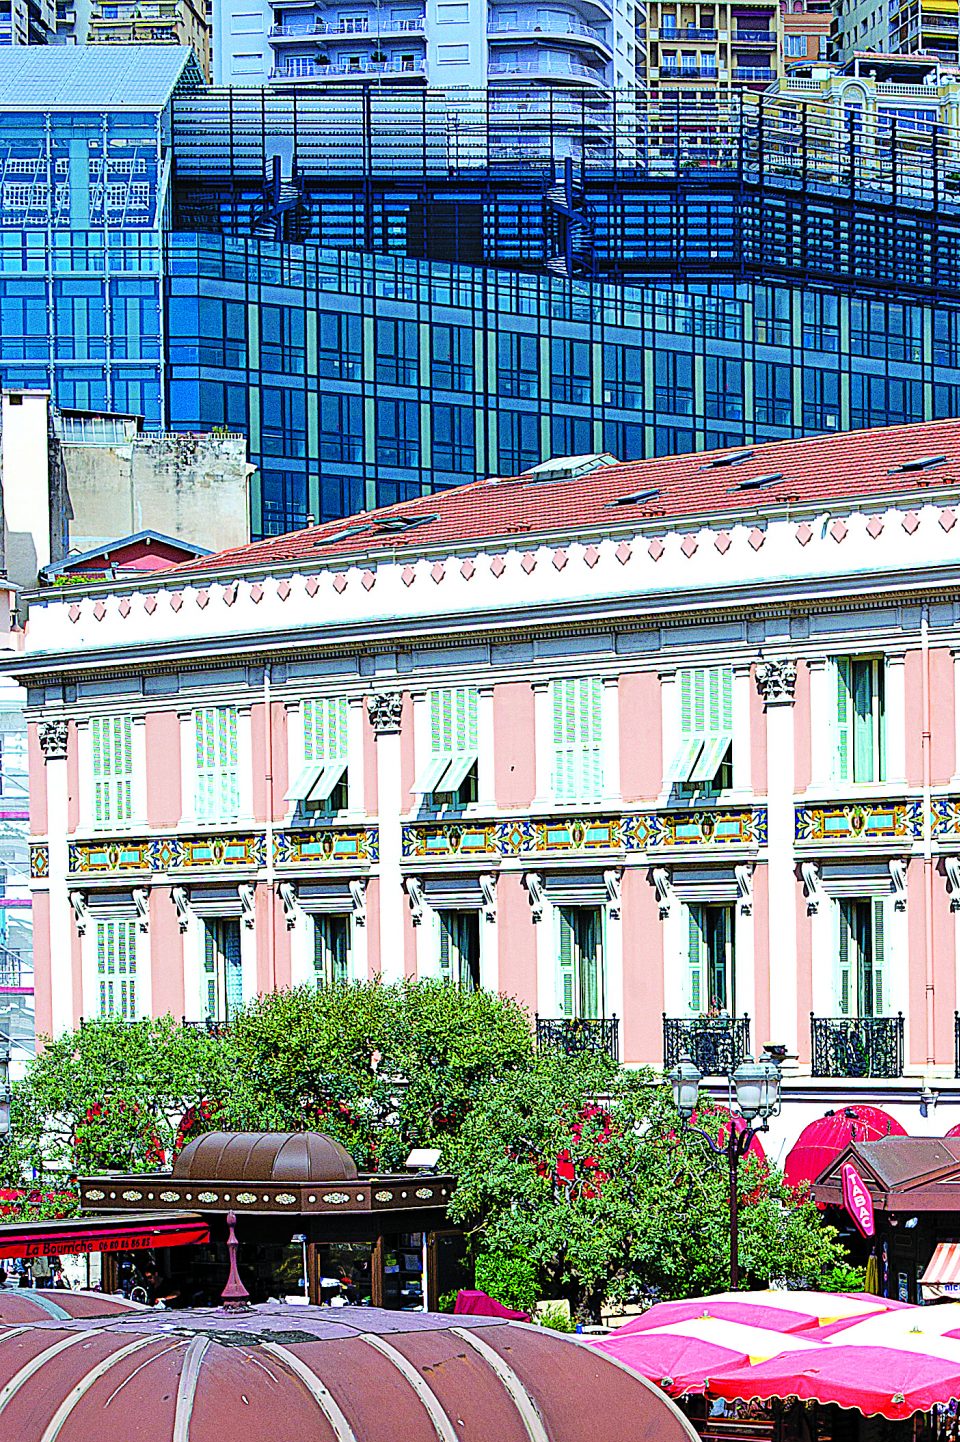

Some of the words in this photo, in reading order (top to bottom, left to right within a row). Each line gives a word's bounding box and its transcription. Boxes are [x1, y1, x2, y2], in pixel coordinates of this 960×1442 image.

[848, 1173, 871, 1228] TABAC
[25, 1243, 39, 1256] La
[42, 1240, 93, 1255] Bourriche
